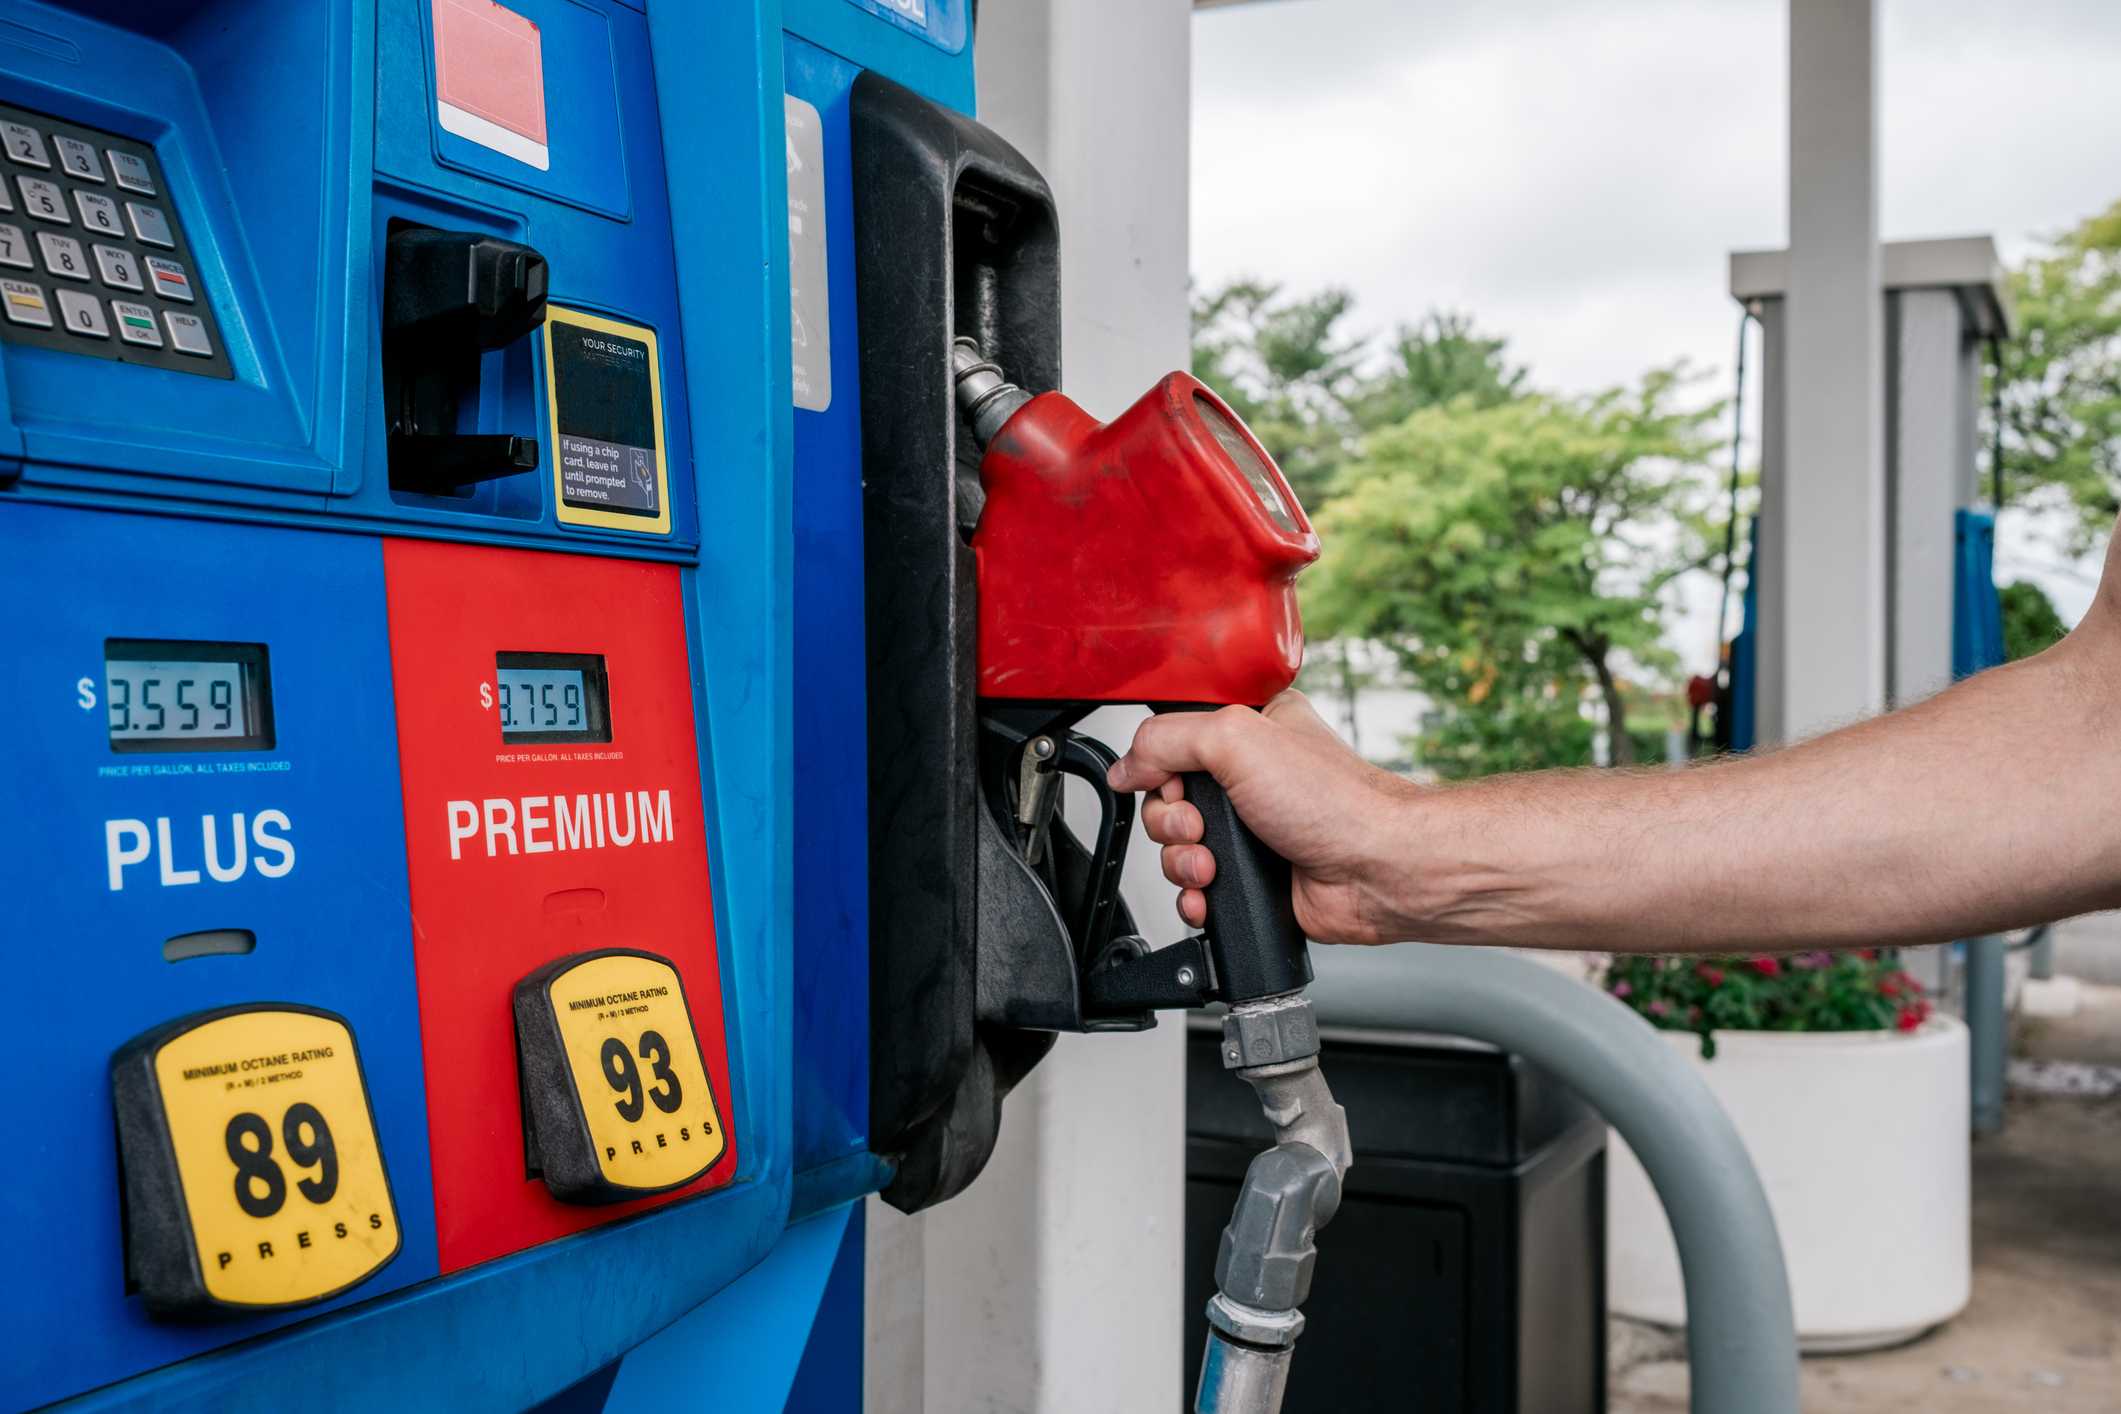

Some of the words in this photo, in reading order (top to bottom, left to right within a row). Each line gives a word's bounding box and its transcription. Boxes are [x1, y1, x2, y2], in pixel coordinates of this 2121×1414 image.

[19, 140, 36, 158] 2
[76, 155, 90, 172] 3
[119, 155, 139, 166] YES
[41, 197, 55, 214] 5
[96, 210, 111, 228] 6
[0, 239, 12, 258] 7
[60, 253, 75, 271] 8
[115, 264, 129, 282] 9
[3, 281, 39, 296] CLEAR
[79, 310, 92, 328] 0
[119, 304, 150, 318] ENTER
[175, 315, 198, 328] HELP
[582, 336, 606, 352] YOUR
[607, 342, 646, 361] SECURITY
[570, 441, 594, 457] using
[601, 446, 620, 461] chip
[586, 457, 610, 471] leave
[565, 471, 585, 483] until
[585, 474, 627, 489] prompted
[565, 485, 576, 496] to
[576, 487, 610, 501] remove.
[77, 677, 97, 710] $
[479, 682, 494, 710] $
[109, 679, 232, 731] 3.559
[498, 683, 580, 726] 3.759
[495, 754, 516, 764] PRICE
[516, 753, 530, 763] PER
[573, 751, 593, 761] TAXES
[593, 750, 624, 760] INCLUDED
[98, 766, 129, 777] PRICE
[131, 765, 151, 776] PER
[196, 762, 215, 774] ALL
[216, 761, 245, 774] TAXES
[247, 760, 292, 773] INCLUDED
[447, 790, 674, 860] PREMIUM
[105, 809, 296, 891] PLUS
[568, 996, 606, 1012] MINIMUM
[606, 991, 639, 1006] OCTANE
[639, 986, 669, 1001] RATING
[625, 1005, 649, 1016] METHOD
[183, 1062, 238, 1081] MINIMUM
[242, 1055, 289, 1073] OCTANE
[292, 1047, 334, 1063] RATING
[267, 1070, 304, 1083] METHOD
[600, 1030, 683, 1122] 93
[606, 1122, 713, 1161] PRESS
[225, 1102, 339, 1219] 89
[217, 1213, 383, 1270] PRESS
